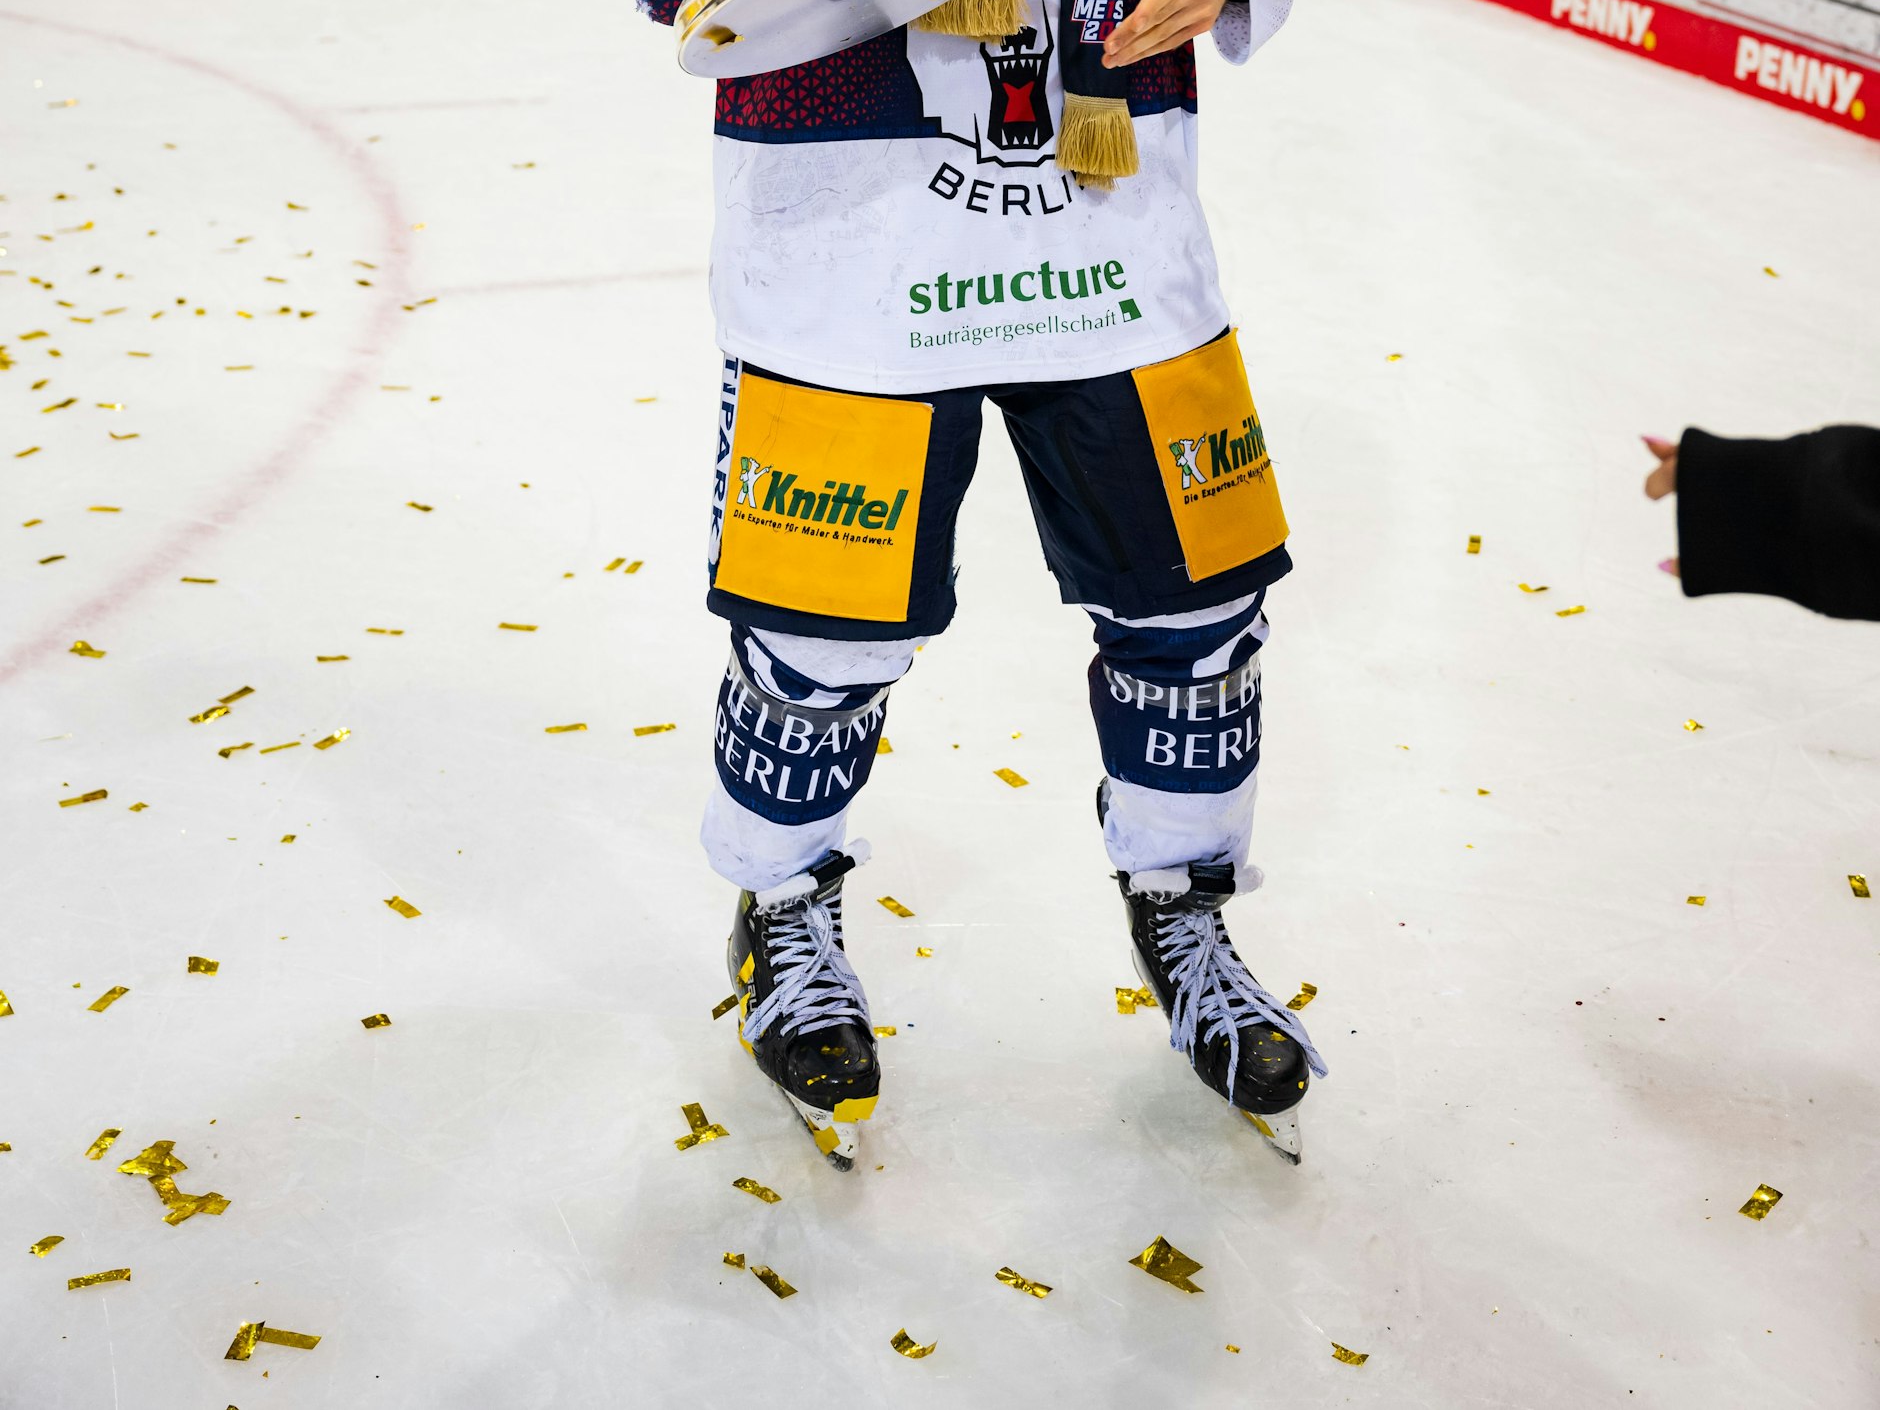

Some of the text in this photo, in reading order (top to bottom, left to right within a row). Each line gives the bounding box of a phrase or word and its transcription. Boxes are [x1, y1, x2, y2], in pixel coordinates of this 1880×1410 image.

[1074, 0, 1123, 20] MEIS
[928, 161, 1074, 216] BERLI
[909, 259, 1127, 315] structure
[910, 310, 1117, 349] Bauträgergesellschaft
[711, 357, 738, 541] TIPARK
[1208, 414, 1267, 479] Knitt
[762, 470, 909, 531] Knittel
[1184, 494, 1199, 505] Die
[1202, 480, 1236, 499] Experten
[733, 509, 745, 520] Die
[747, 513, 782, 530] Experten
[785, 521, 798, 533] für
[802, 525, 830, 539] Maler
[832, 530, 840, 540] &
[714, 704, 858, 803] BERLIN
[1145, 702, 1262, 769] BERL
